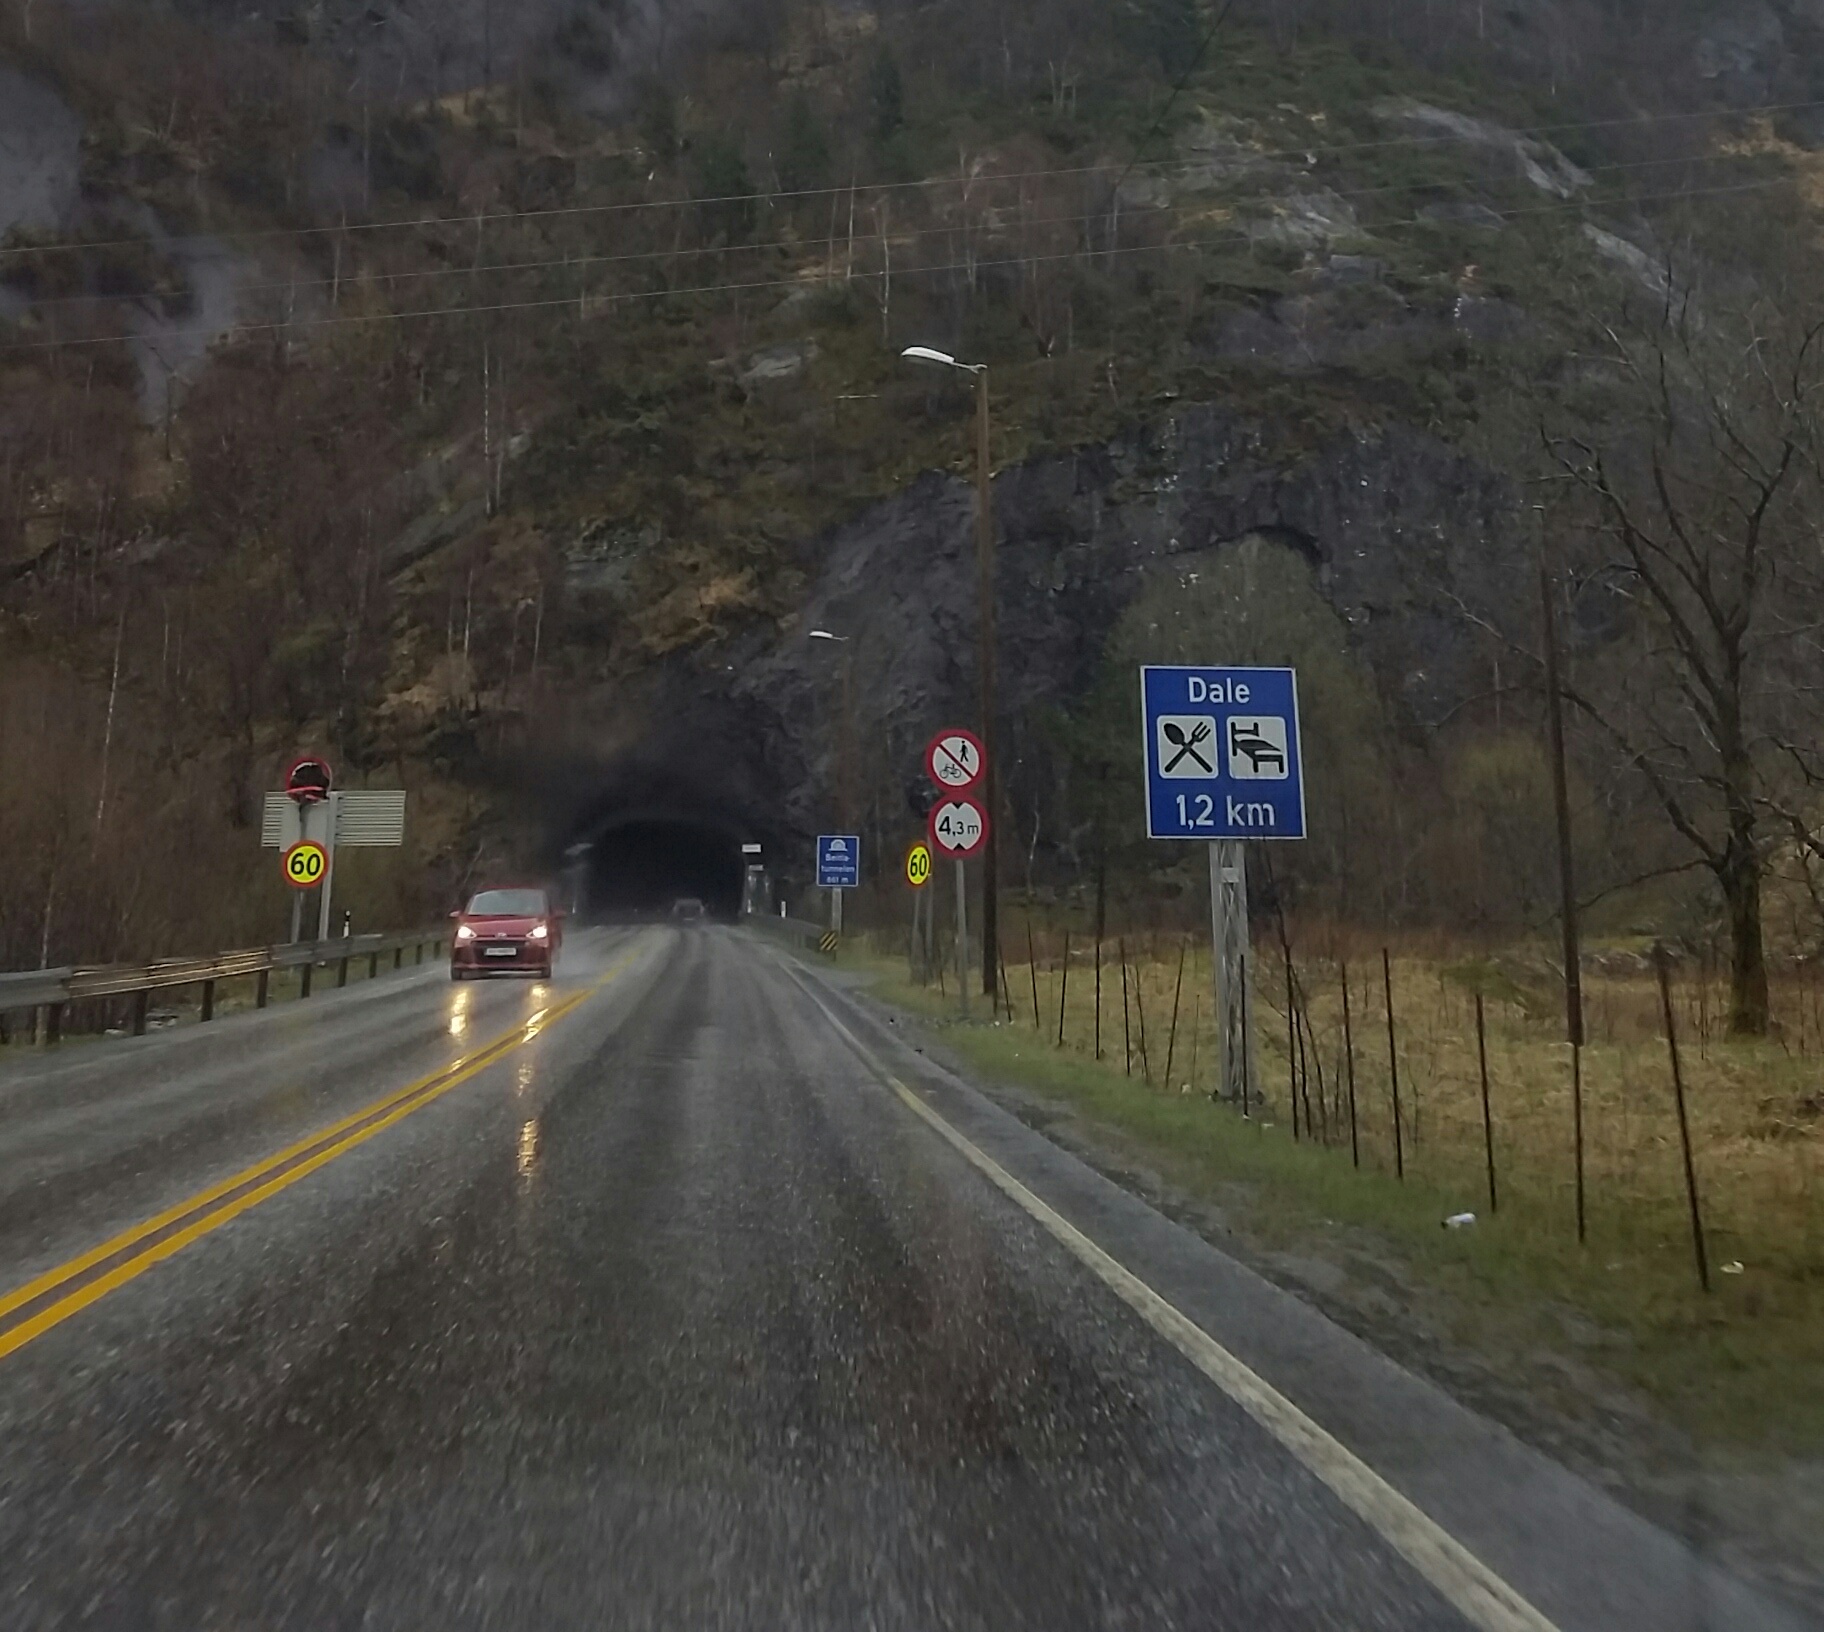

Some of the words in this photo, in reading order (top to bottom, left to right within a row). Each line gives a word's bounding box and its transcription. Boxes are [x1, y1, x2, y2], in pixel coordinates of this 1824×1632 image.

[1188, 677, 1250, 704] Dale
[1176, 794, 1214, 830] 1,2
[1226, 795, 1275, 827] km
[290, 852, 321, 876] 60
[909, 853, 927, 877] 60
